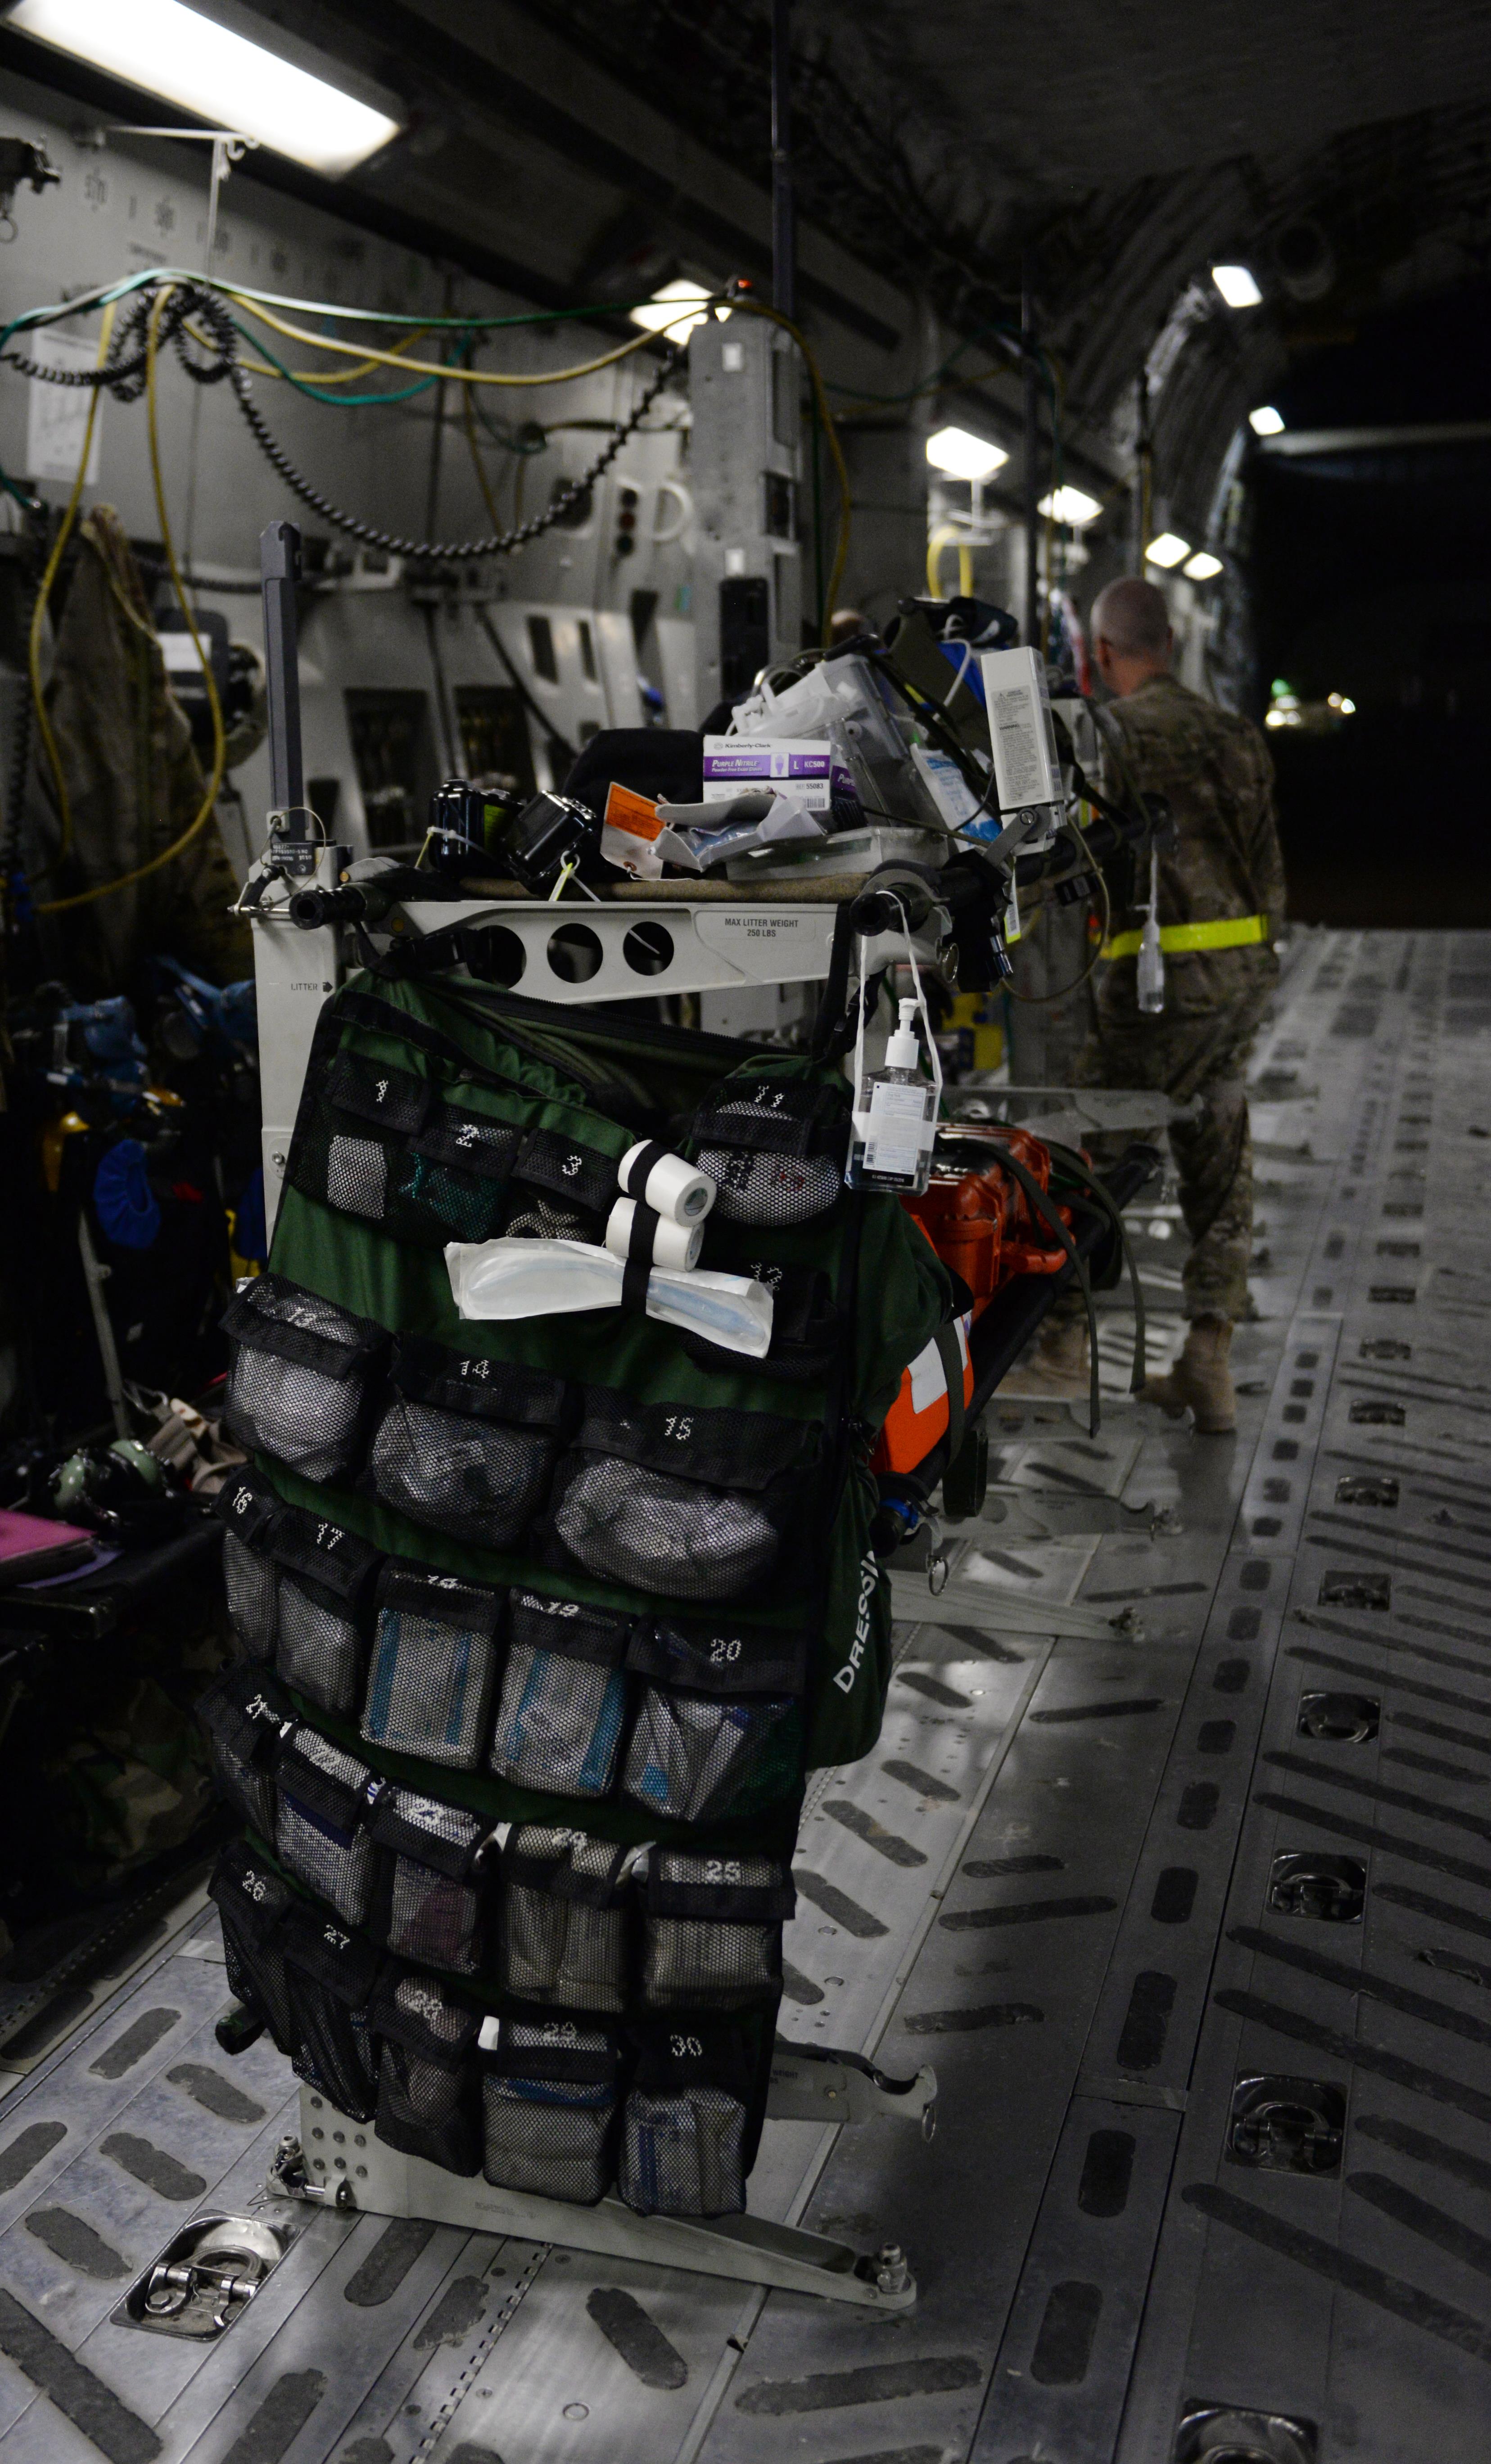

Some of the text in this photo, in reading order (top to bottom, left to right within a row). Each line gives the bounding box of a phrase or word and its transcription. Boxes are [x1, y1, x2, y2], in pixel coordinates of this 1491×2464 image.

[794, 761, 799, 770] L
[376, 1080, 388, 1103] 1
[456, 1124, 479, 1148] 2
[562, 1155, 581, 1175] 3
[459, 1359, 490, 1379] 14
[664, 1416, 693, 1440] 15
[232, 1486, 253, 1514] 16
[316, 1522, 345, 1550] 17
[709, 1638, 742, 1662] 20
[705, 1860, 741, 1882] 25
[242, 1870, 267, 1900] 26
[324, 1924, 350, 1950] 27
[670, 2034, 703, 2056] 30
